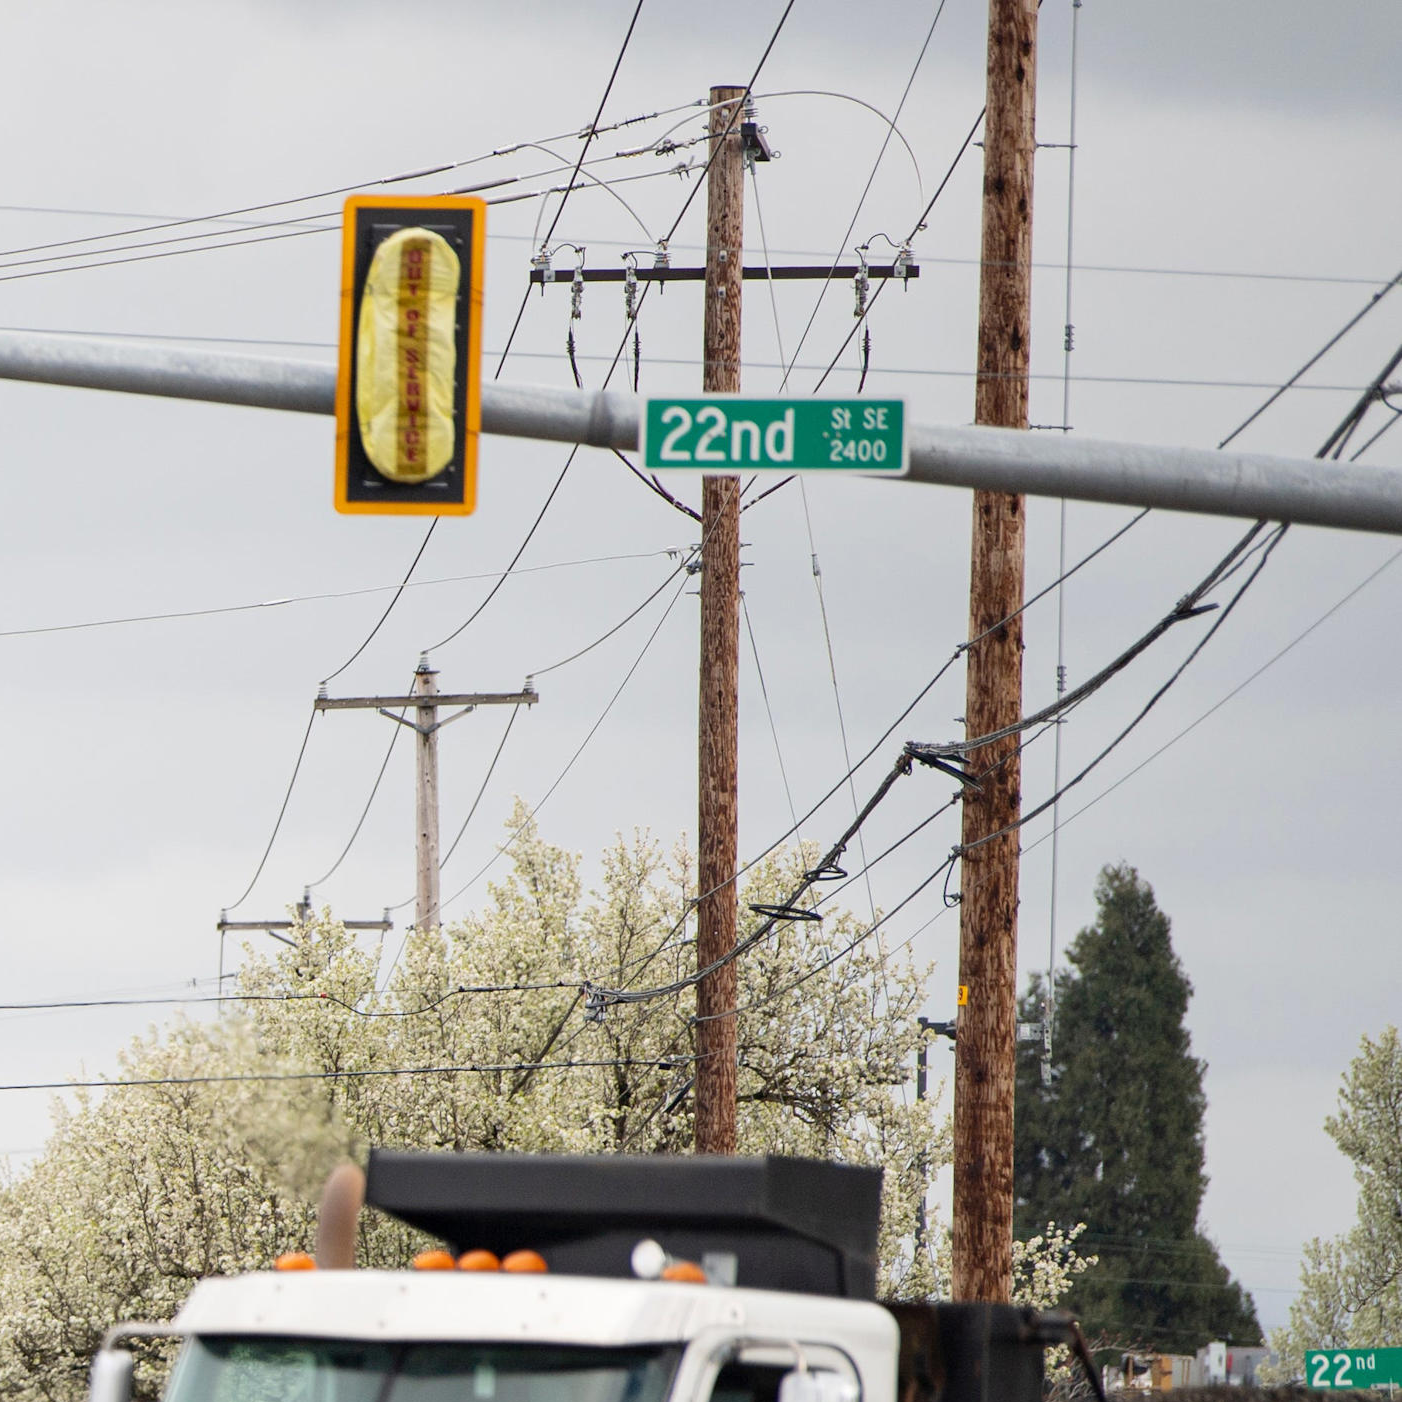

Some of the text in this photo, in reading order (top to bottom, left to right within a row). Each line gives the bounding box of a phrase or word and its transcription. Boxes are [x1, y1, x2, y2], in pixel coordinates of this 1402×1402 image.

[406, 249, 423, 297] OUT
[659, 406, 795, 462] 22nd
[831, 407, 888, 430] St SE
[829, 439, 887, 462] 2400
[1311, 1352, 1376, 1388] 22nd
